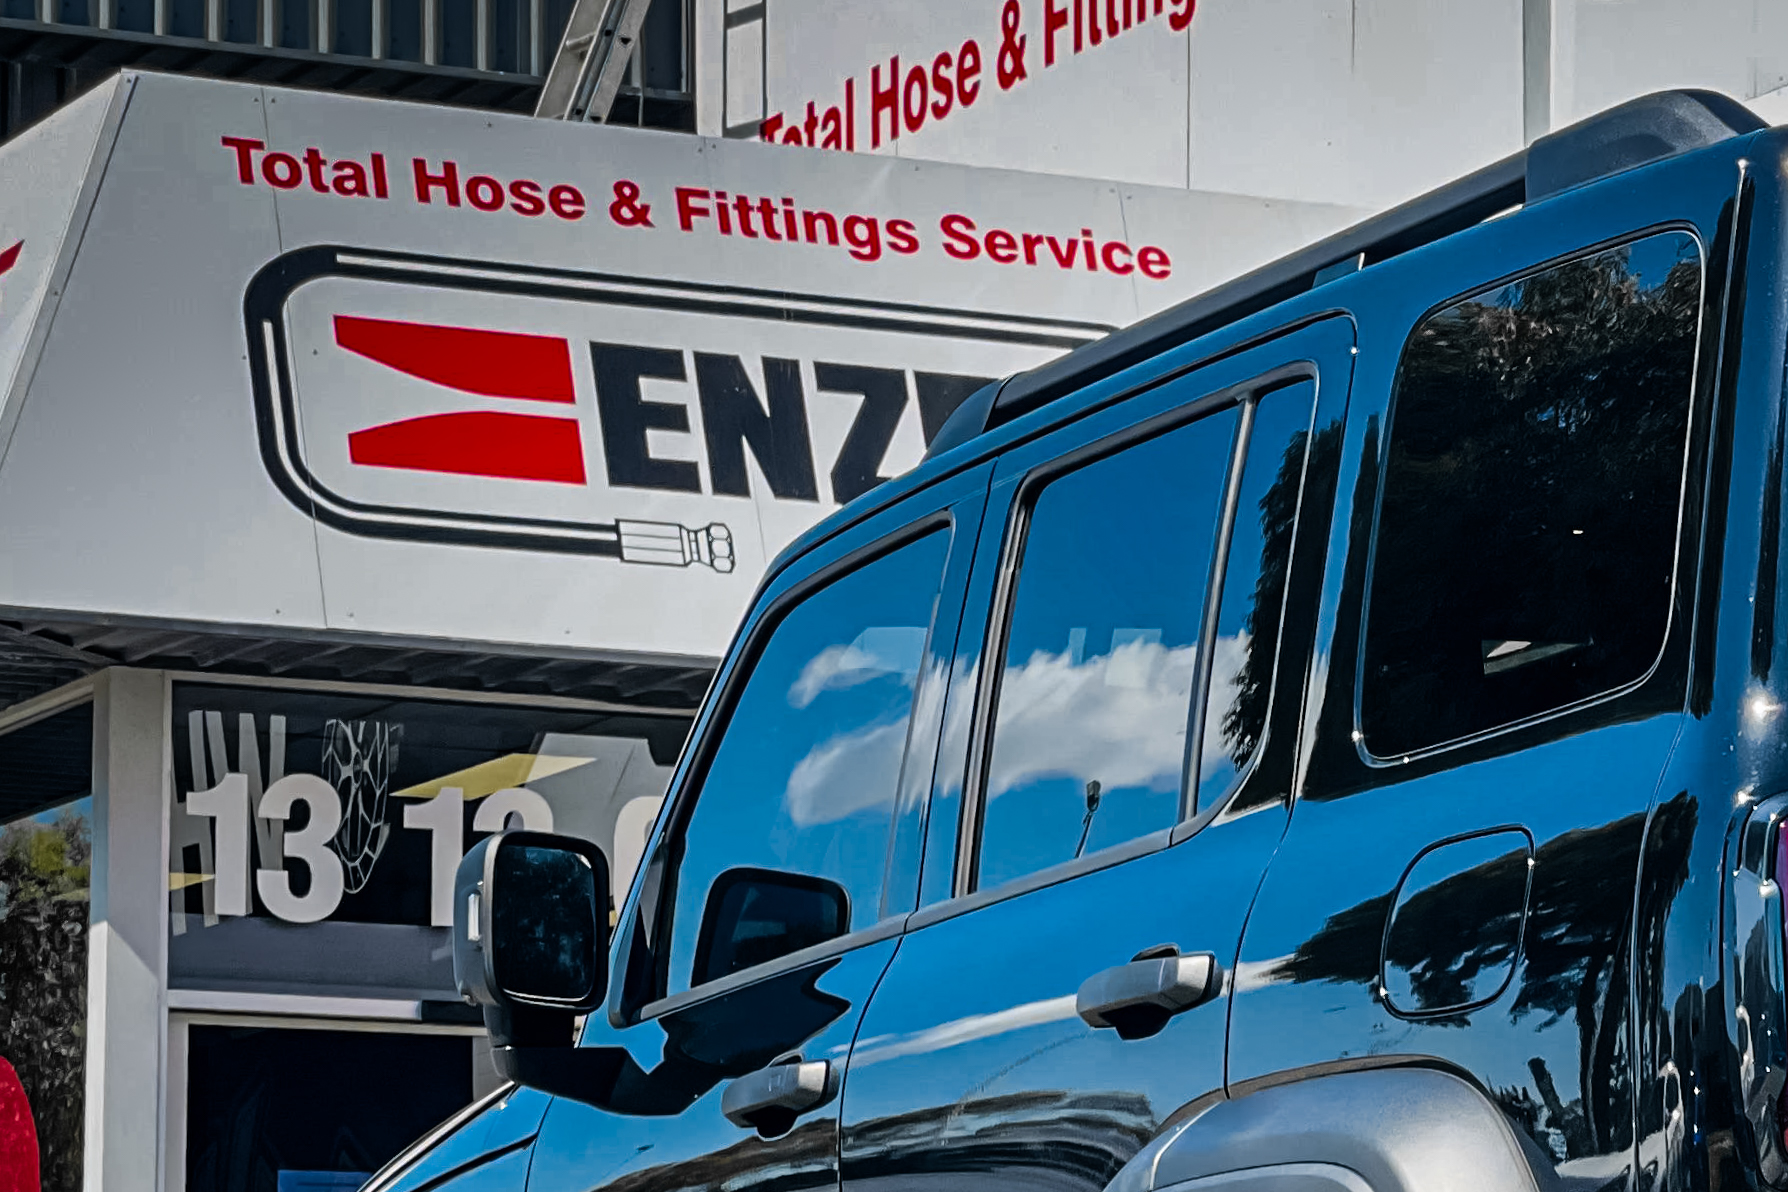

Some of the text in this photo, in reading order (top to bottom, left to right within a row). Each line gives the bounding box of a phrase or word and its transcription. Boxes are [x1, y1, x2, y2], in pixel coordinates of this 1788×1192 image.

[871, 40, 983, 150] Hose
[997, 0, 1027, 90] &
[222, 136, 1172, 281] Total Hose & Fittings Service
[589, 340, 999, 505] ENZ
[185, 773, 345, 924] 13
